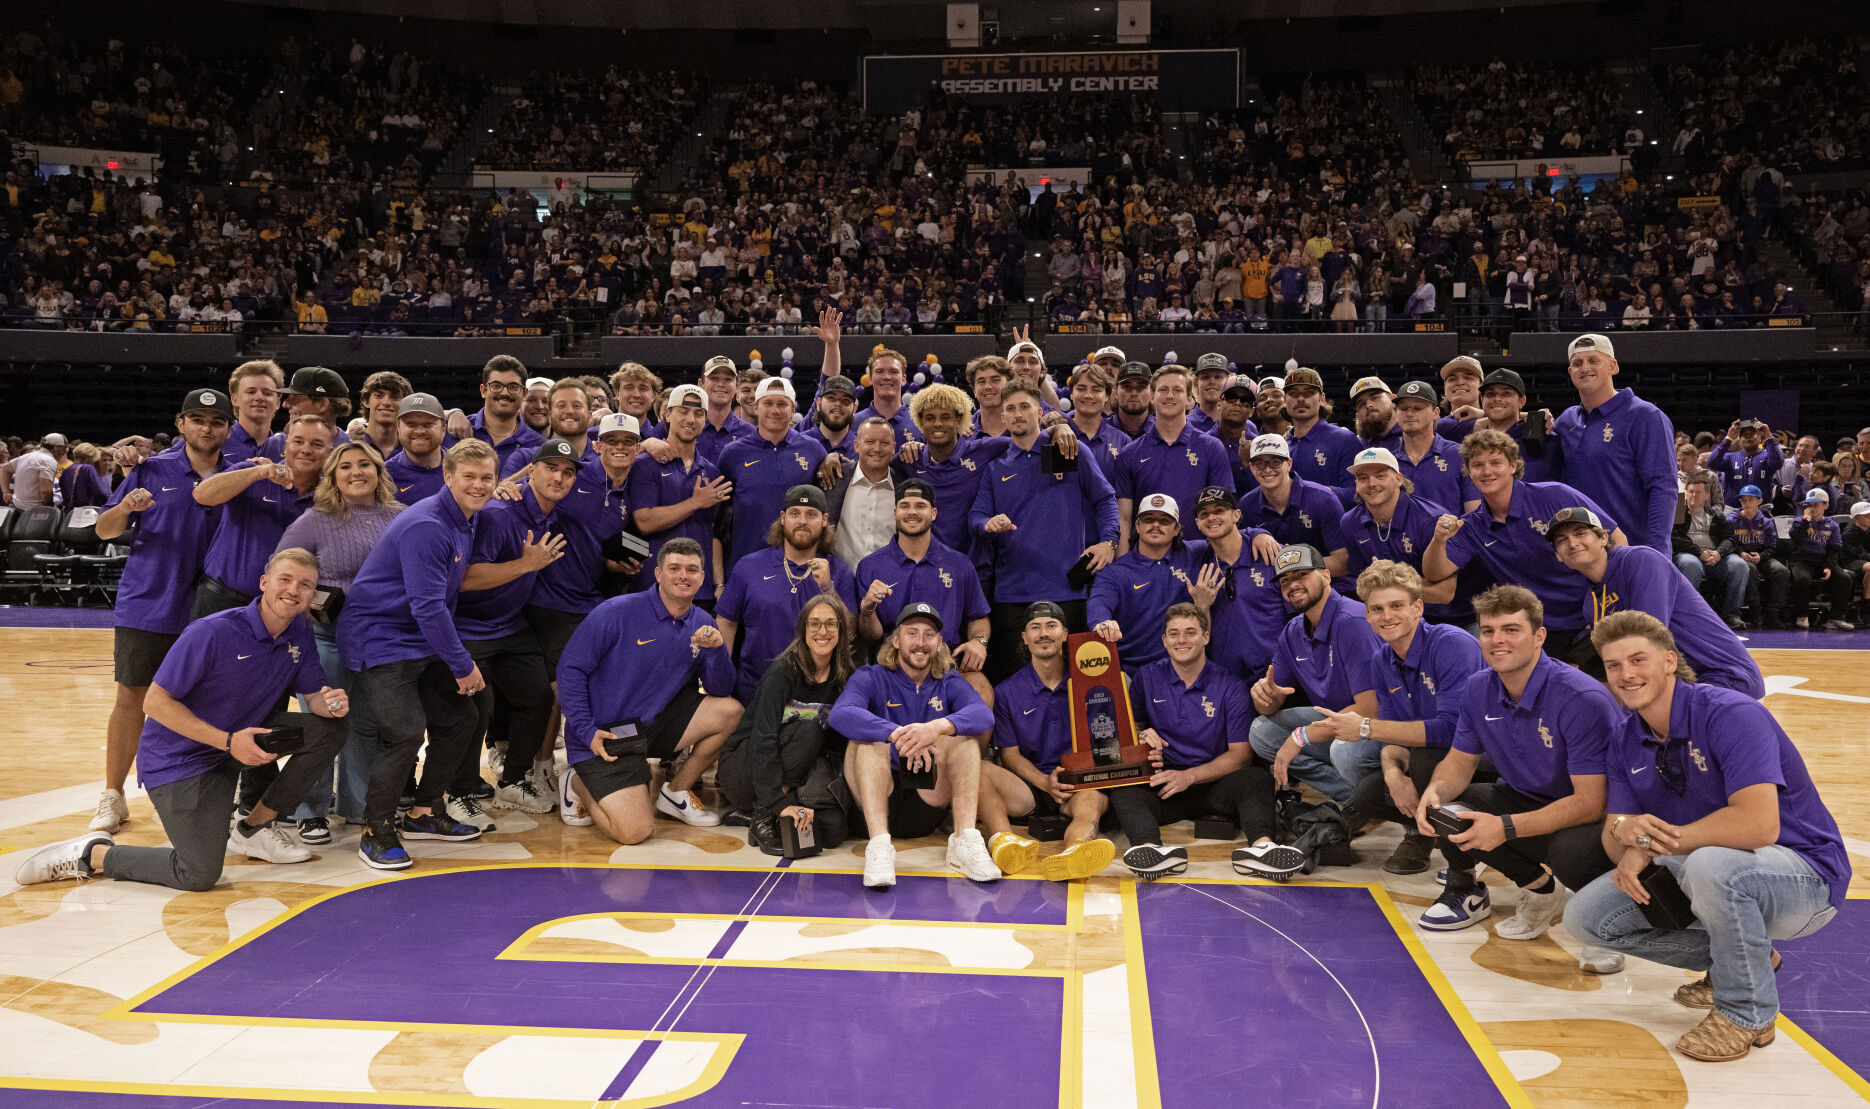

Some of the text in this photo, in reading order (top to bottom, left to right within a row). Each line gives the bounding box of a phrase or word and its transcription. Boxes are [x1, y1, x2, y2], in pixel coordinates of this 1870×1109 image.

[941, 53, 1160, 76] PETE MARAVICH
[941, 75, 1160, 94] ASSEMBLY CENTER
[613, 414, 627, 426] T
[794, 452, 808, 470] LSU
[960, 457, 976, 471] LSU
[1186, 448, 1199, 466] LSU
[1314, 449, 1327, 466] LSU
[1434, 455, 1448, 472] LSU
[1199, 488, 1225, 503] LSU
[1299, 510, 1312, 528] LSU
[1528, 517, 1549, 536] LSU
[1401, 532, 1413, 553] LSU
[939, 568, 953, 588] LSU
[1250, 568, 1265, 587] LSU
[288, 641, 302, 663] LSU
[1079, 656, 1110, 670] NCAA
[1419, 671, 1436, 695] LSU
[1201, 696, 1216, 718] LSU
[1537, 718, 1554, 748] LSU
[1687, 741, 1708, 771] LSU
[1083, 768, 1140, 783] NATIONAL CHAMPION
